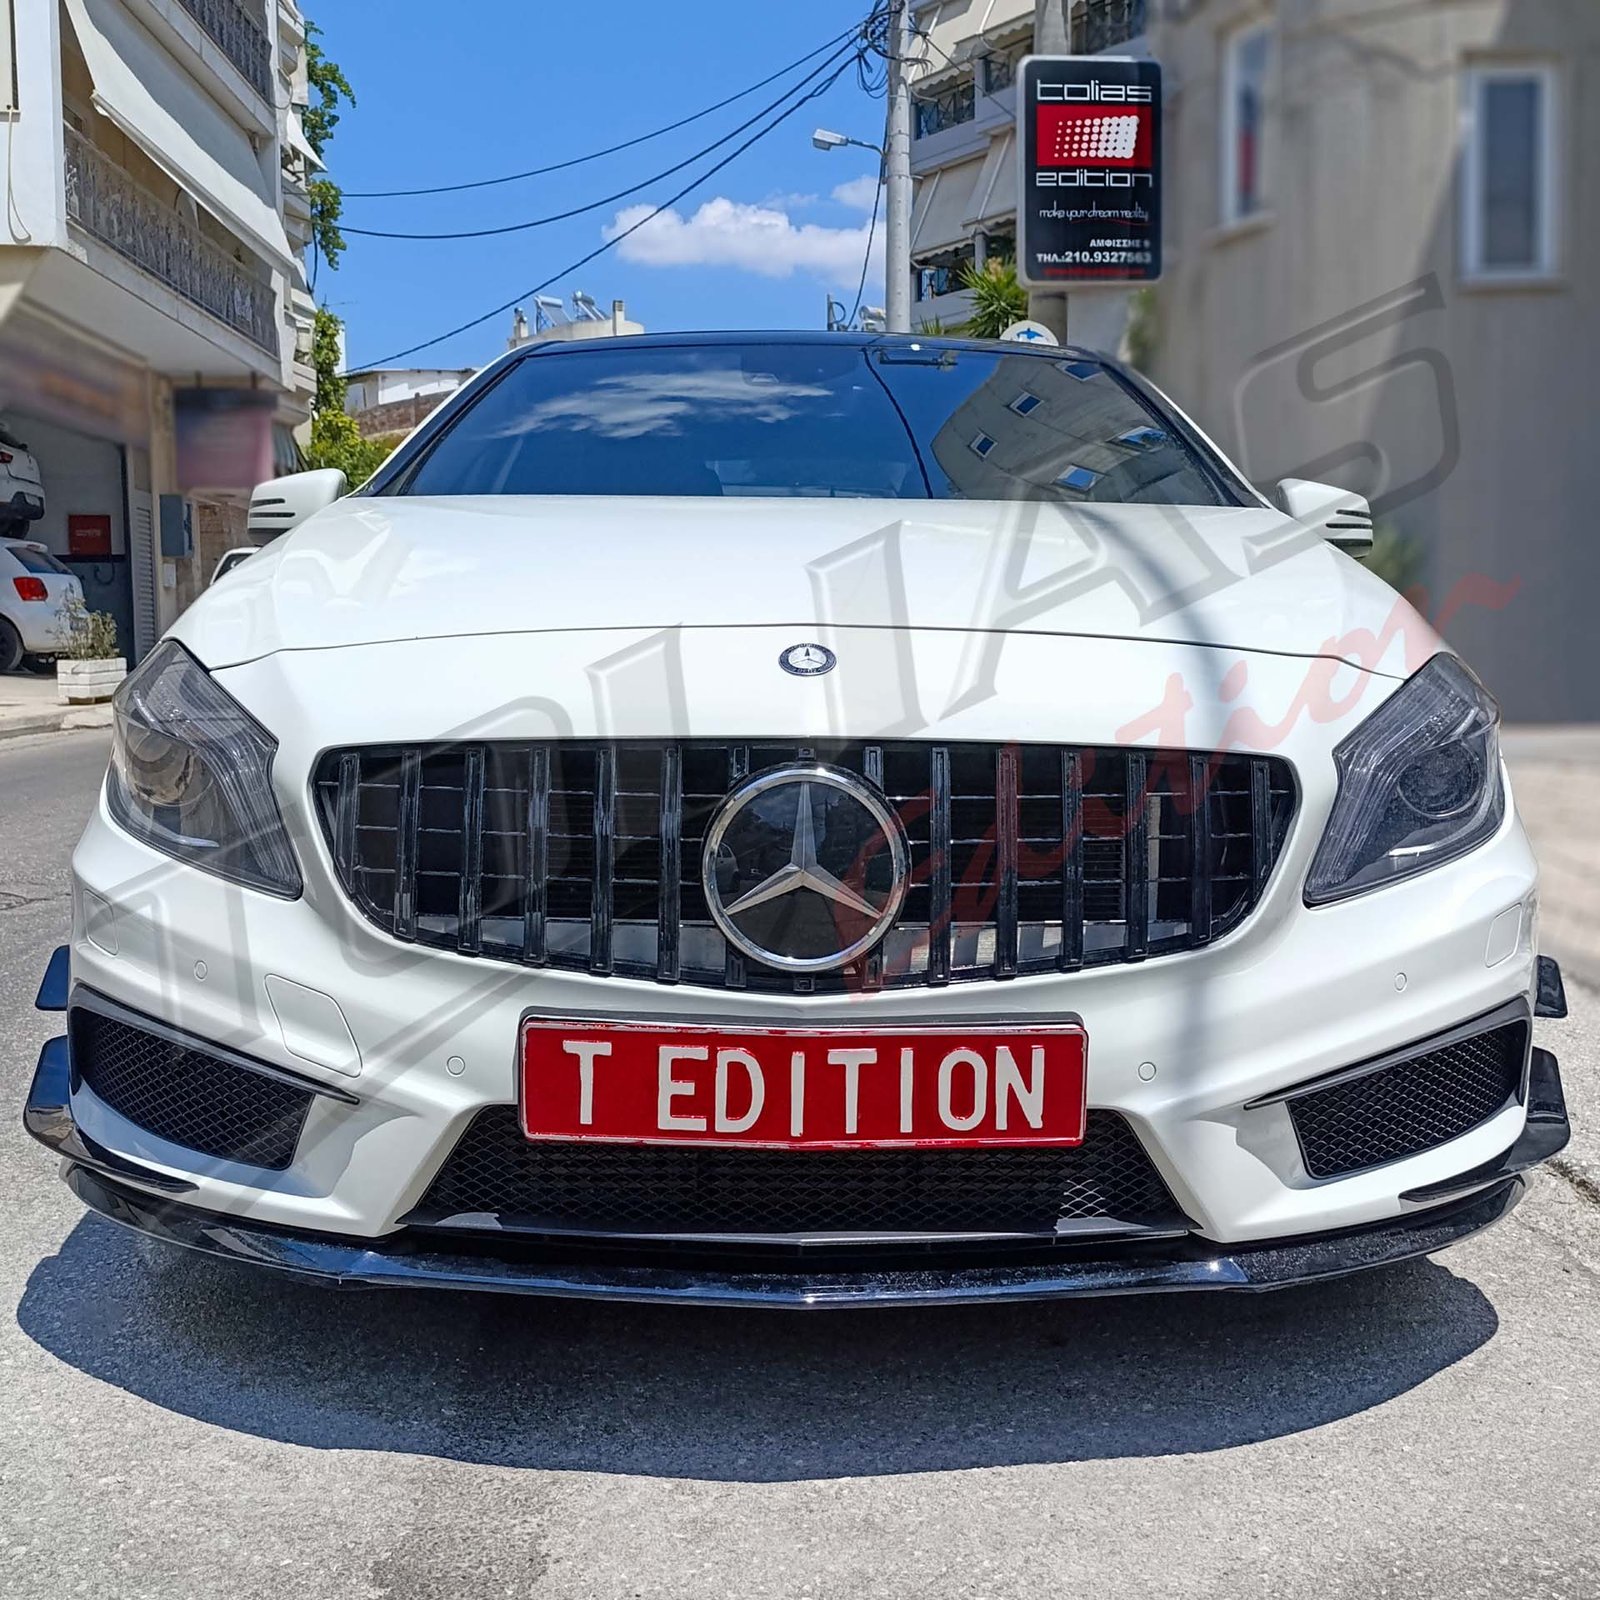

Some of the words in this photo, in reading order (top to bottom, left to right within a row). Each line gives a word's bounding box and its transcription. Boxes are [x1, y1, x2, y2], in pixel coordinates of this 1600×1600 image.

[1036, 79, 1152, 102] tolias
[1036, 169, 1152, 187] edition
[1039, 200, 1064, 219] make
[1066, 209, 1087, 221] your
[1088, 200, 1119, 218] dream
[562, 1040, 612, 1126] T
[657, 1045, 1045, 1138] EDITION
